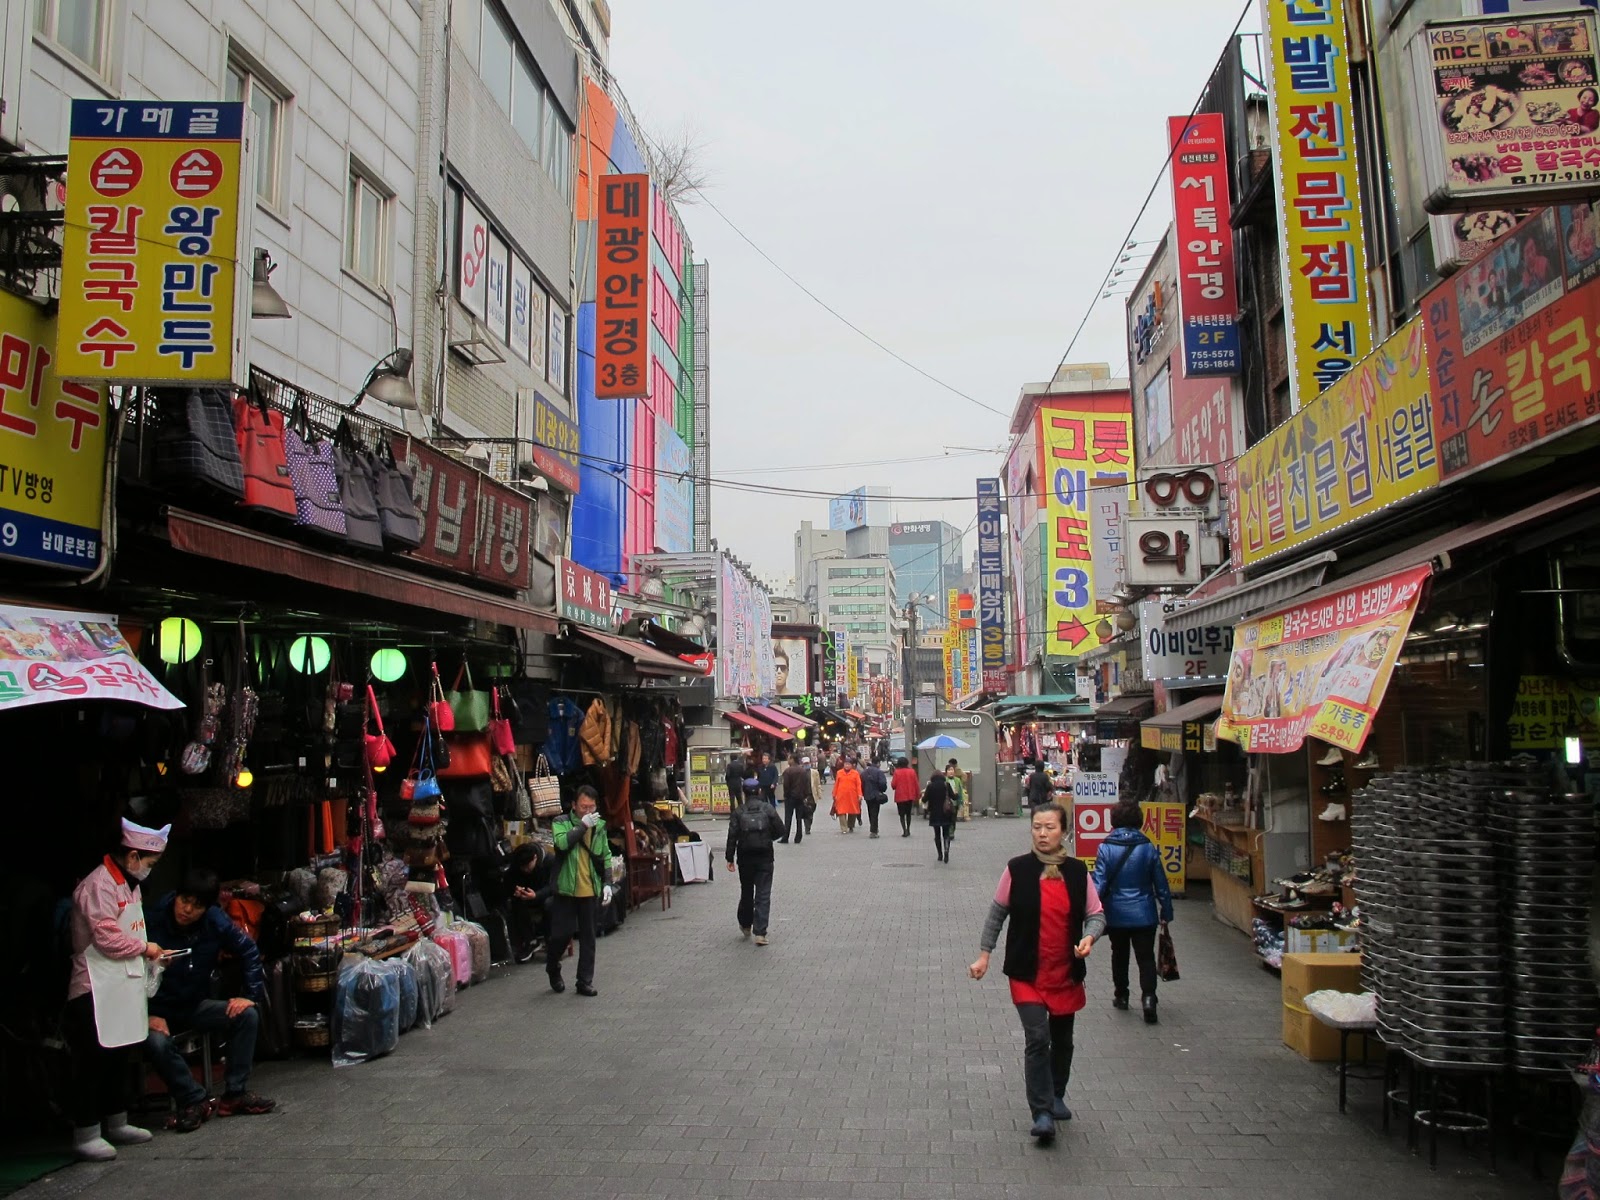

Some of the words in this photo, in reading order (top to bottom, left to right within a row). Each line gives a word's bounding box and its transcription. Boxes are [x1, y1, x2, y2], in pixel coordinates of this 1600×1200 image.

[1430, 29, 1467, 44] KBS
[1433, 45, 1482, 61] MBC
[97, 107, 219, 134] 가메골
[97, 151, 133, 189] 손
[177, 152, 214, 191] 손
[1499, 154, 1523, 173] 손
[1535, 148, 1600, 172] 칼국수
[1529, 169, 1600, 184] 777-9188
[1180, 175, 1225, 299] 서독안경
[603, 181, 644, 356] 대광안경
[78, 205, 145, 368] 칼국수
[157, 205, 222, 369] 왕만두
[1191, 349, 1235, 359] 755-5578
[1191, 360, 1236, 369] 755-1864
[601, 362, 640, 388] 3층
[1467, 367, 1505, 437] 손
[535, 400, 579, 468] 대광안경
[1051, 416, 1131, 466] 그릇
[1245, 412, 1374, 555] 신발전문점
[1376, 392, 1436, 486] 서울발
[903, 524, 931, 533] 한화생명
[42, 530, 97, 559] 남대문본점
[566, 566, 607, 610] 京城社
[981, 557, 1003, 623] 도매상가
[1283, 607, 1311, 638] 칼국수
[1359, 584, 1393, 617] 보리밥
[983, 626, 1004, 660] 3층
[1185, 660, 1208, 676] 2F
[813, 696, 828, 707] 안경
[1328, 702, 1367, 730] 가동중
[1161, 732, 1181, 750] COFFEE
[1185, 722, 1200, 753] 커피
[1250, 722, 1276, 749] 칼국수
[1075, 780, 1118, 798] 이비인후과
[1141, 806, 1185, 843] 서독
